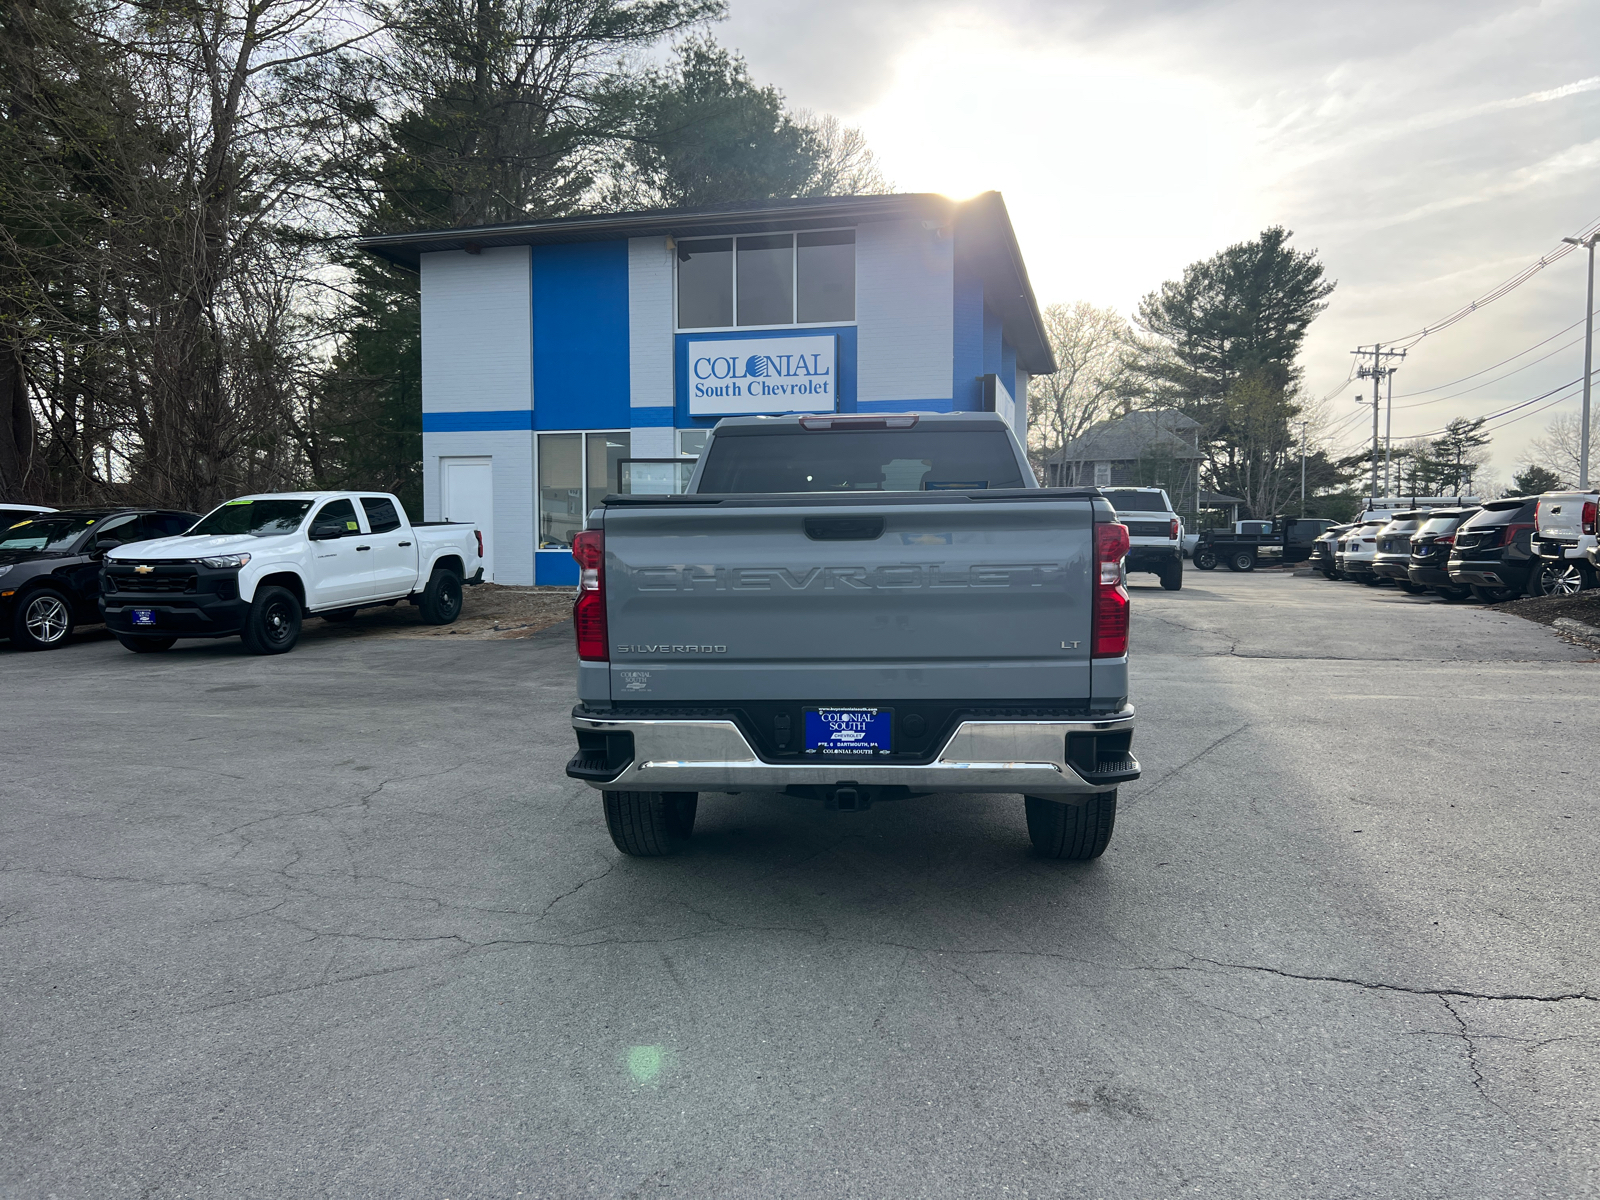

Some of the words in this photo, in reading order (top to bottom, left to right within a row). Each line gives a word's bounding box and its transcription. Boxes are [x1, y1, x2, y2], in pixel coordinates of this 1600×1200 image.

[694, 353, 829, 379] COLONIAL
[695, 382, 742, 398] South
[748, 380, 829, 396] Chevrolet
[637, 563, 1059, 592] CHEVROLET
[617, 644, 728, 654] SILVERADO
[1060, 640, 1082, 650] LT
[821, 713, 874, 722] COLONIAL
[830, 722, 866, 730] SOUTH
